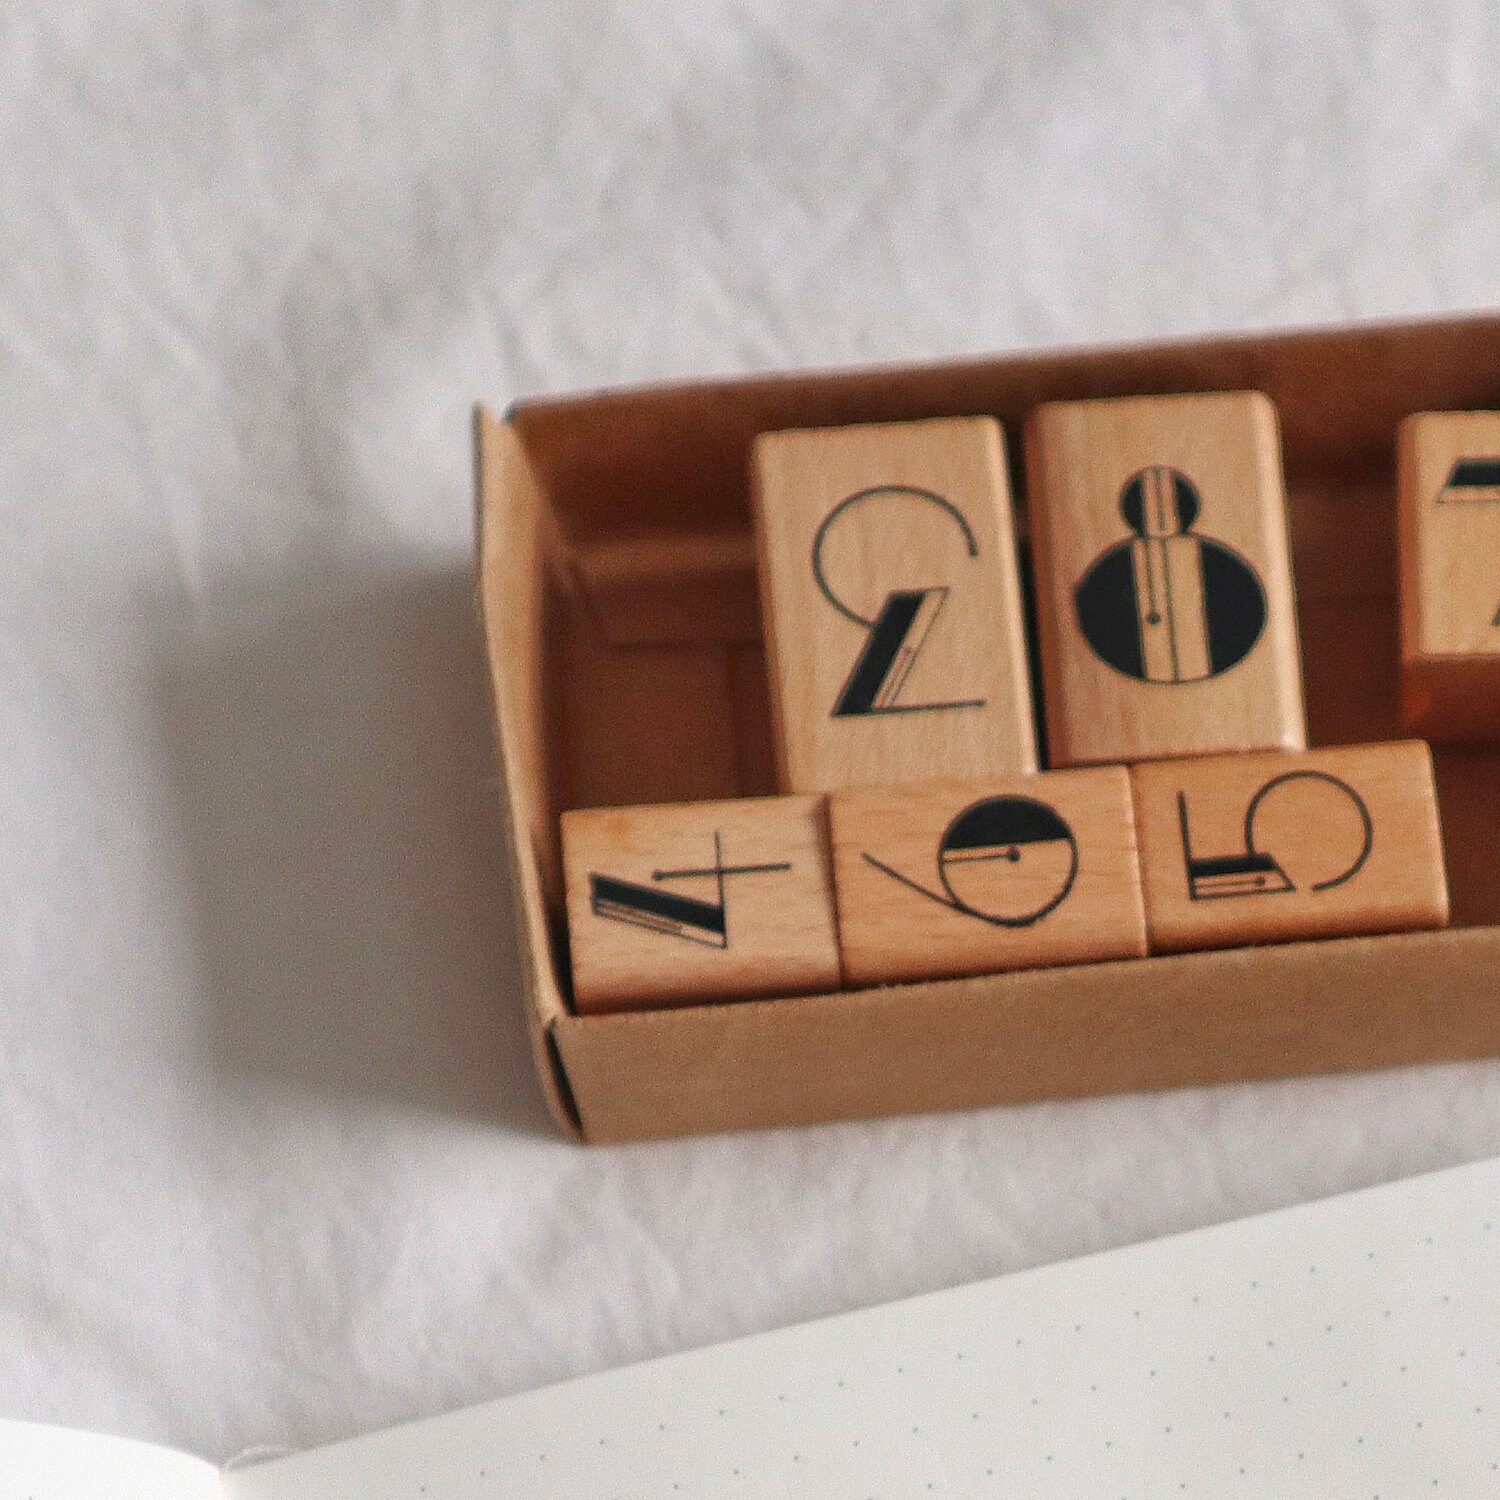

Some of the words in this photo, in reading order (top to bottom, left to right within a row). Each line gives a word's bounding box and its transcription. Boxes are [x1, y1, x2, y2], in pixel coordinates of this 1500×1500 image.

[1071, 464, 1268, 685] 8
[588, 829, 793, 949] 4
[1176, 769, 1374, 901] 5
